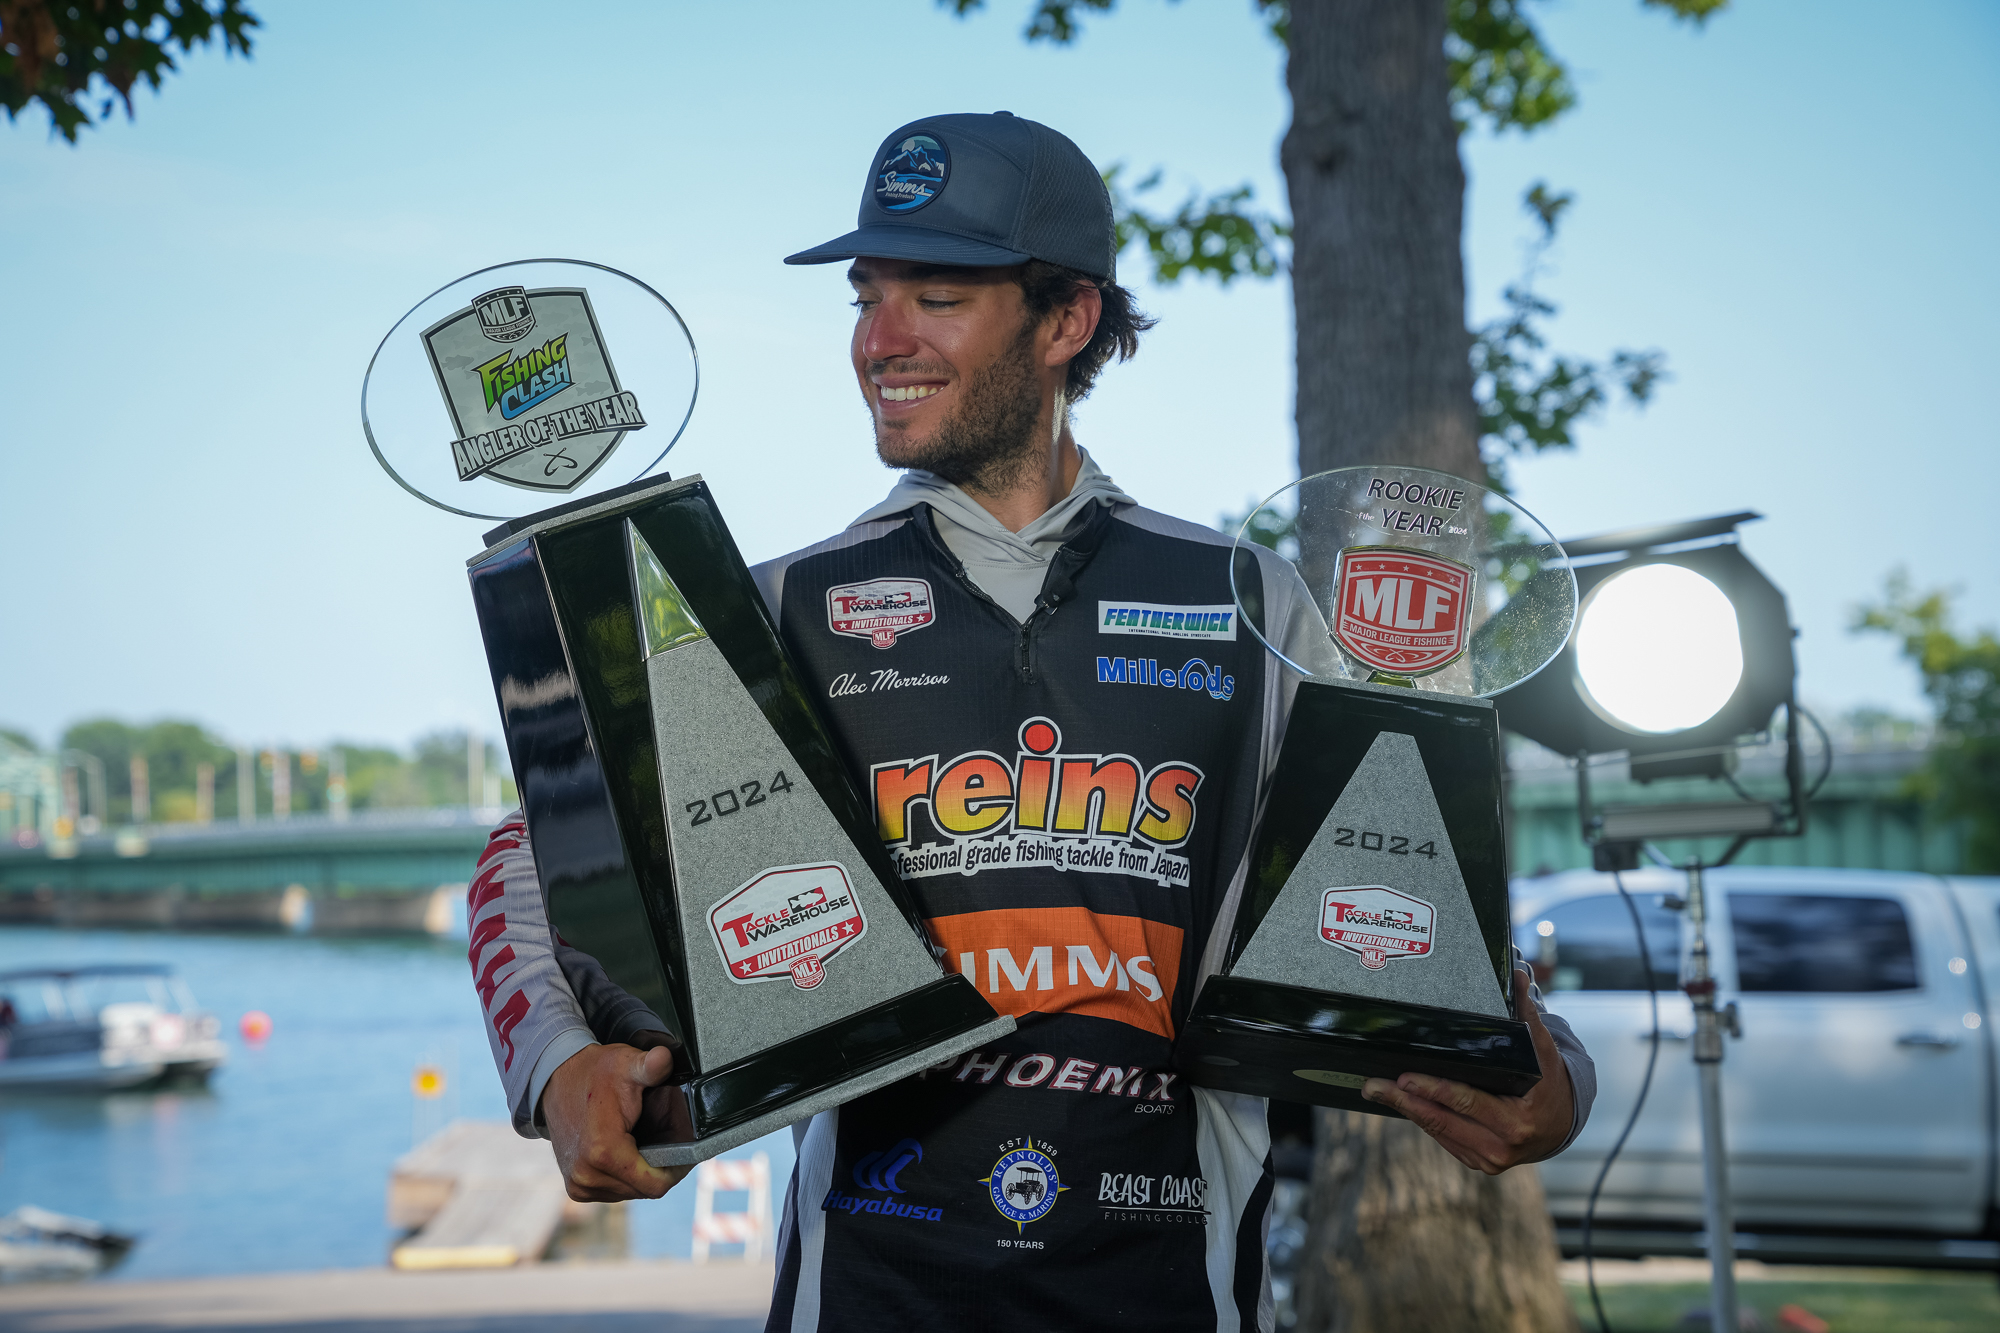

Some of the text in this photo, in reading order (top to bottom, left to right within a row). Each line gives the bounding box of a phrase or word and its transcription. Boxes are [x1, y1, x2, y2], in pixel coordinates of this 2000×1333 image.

[877, 171, 932, 197] Simms
[480, 297, 525, 326] MLF
[501, 357, 573, 420] CLASH
[453, 394, 643, 476] ANGLER OF THE YEAR
[1366, 478, 1465, 510] ROOKIE
[1381, 508, 1444, 536] YEAR
[1449, 526, 1468, 535] 2024
[850, 600, 927, 612] WAREHOUSE
[1352, 577, 1452, 630] MLF
[851, 615, 913, 629] INVITATIONALS
[1104, 608, 1232, 632] FEATHERWICK
[1350, 623, 1447, 646] MAJOR LEAGUE FISHING
[874, 632, 892, 641] MLF
[829, 668, 950, 698] Alec Morrison
[1097, 657, 1235, 695] Millerods
[871, 717, 1204, 848] reins
[686, 771, 794, 827] 2024
[1334, 828, 1438, 859] 2024
[965, 841, 1010, 870] grade
[1016, 840, 1063, 865] fishing
[1067, 843, 1113, 868] tackle
[1117, 848, 1148, 871] from
[1150, 853, 1189, 881] Japan
[746, 895, 850, 942] WAREHOUSE
[1328, 902, 1381, 922] TACKLE
[1345, 915, 1428, 933] WAREHOUSE
[721, 908, 789, 947] TACKLE
[1341, 932, 1410, 950] INVITATIONALS
[757, 925, 839, 969] INVITATIONALS
[1364, 951, 1384, 961] MLF
[794, 961, 818, 979] MLF
[935, 944, 1163, 1002] IMMS
[1134, 1103, 1175, 1114] BOATS
[999, 1138, 1057, 1156] EST 1859
[994, 1151, 1057, 1184] REYNOLDS'
[993, 1186, 1055, 1220] GARAGE & MARINE
[1098, 1172, 1207, 1208] BEAST COAST
[823, 1190, 943, 1221] Hayabusa
[1104, 1212, 1161, 1222] FISHING
[997, 1240, 1044, 1250] 150 YEARS
